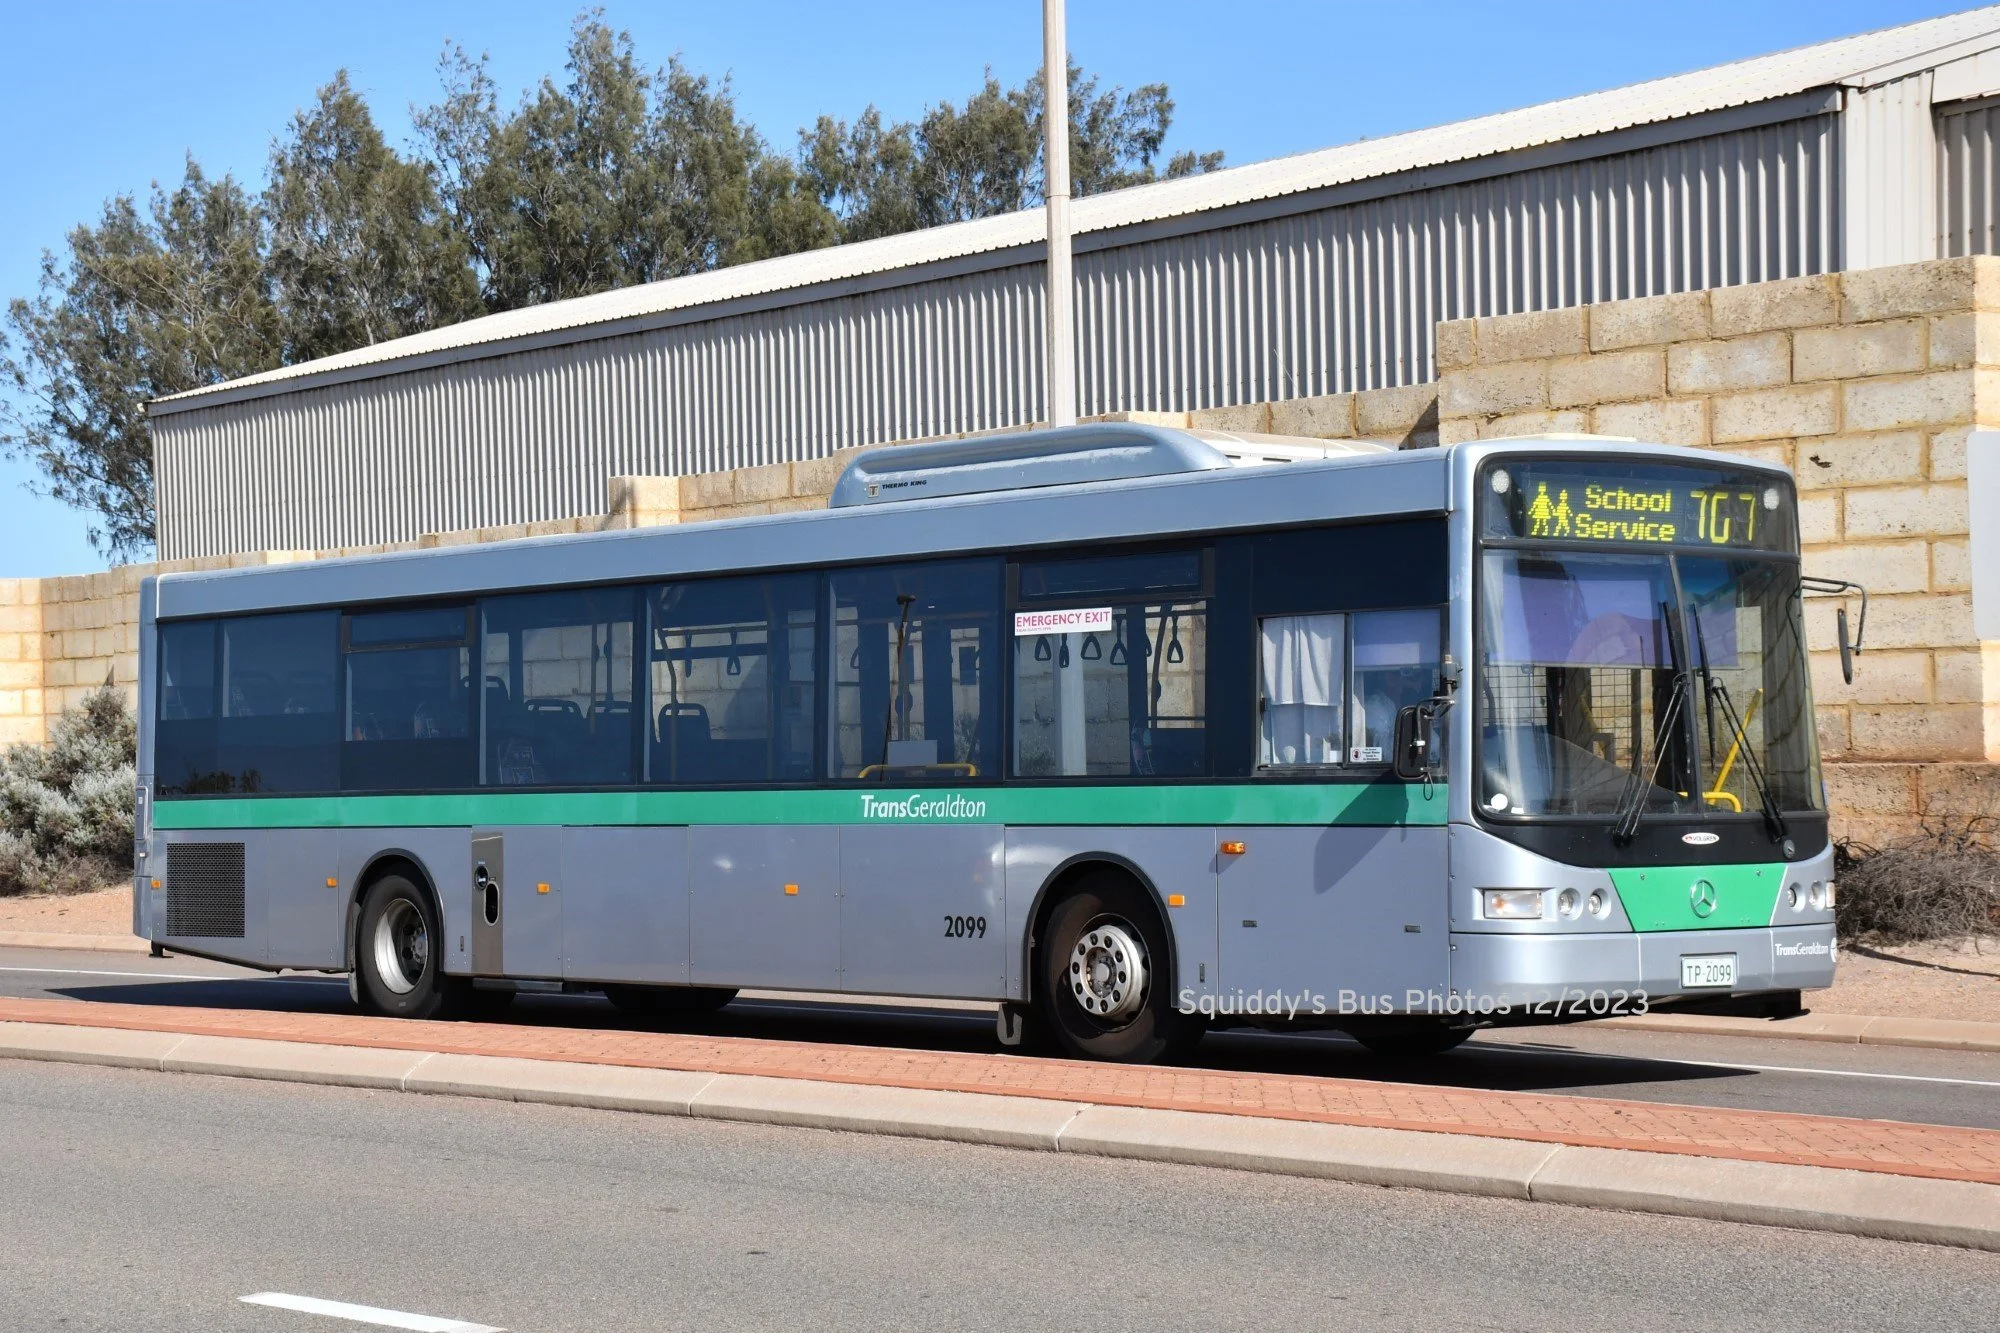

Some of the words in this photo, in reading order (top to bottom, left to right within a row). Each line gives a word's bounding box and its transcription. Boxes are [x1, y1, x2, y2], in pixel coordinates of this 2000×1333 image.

[882, 481, 909, 490] THERMO
[910, 479, 927, 487] KING
[1585, 484, 1672, 513] School
[1574, 513, 1676, 542] Service
[1016, 612, 1082, 628] EMERGENCY
[1085, 611, 1111, 624] EXIT
[861, 794, 986, 818] TransGeraldton
[943, 915, 987, 939] 2099
[1775, 942, 1829, 956] TransGeraldton
